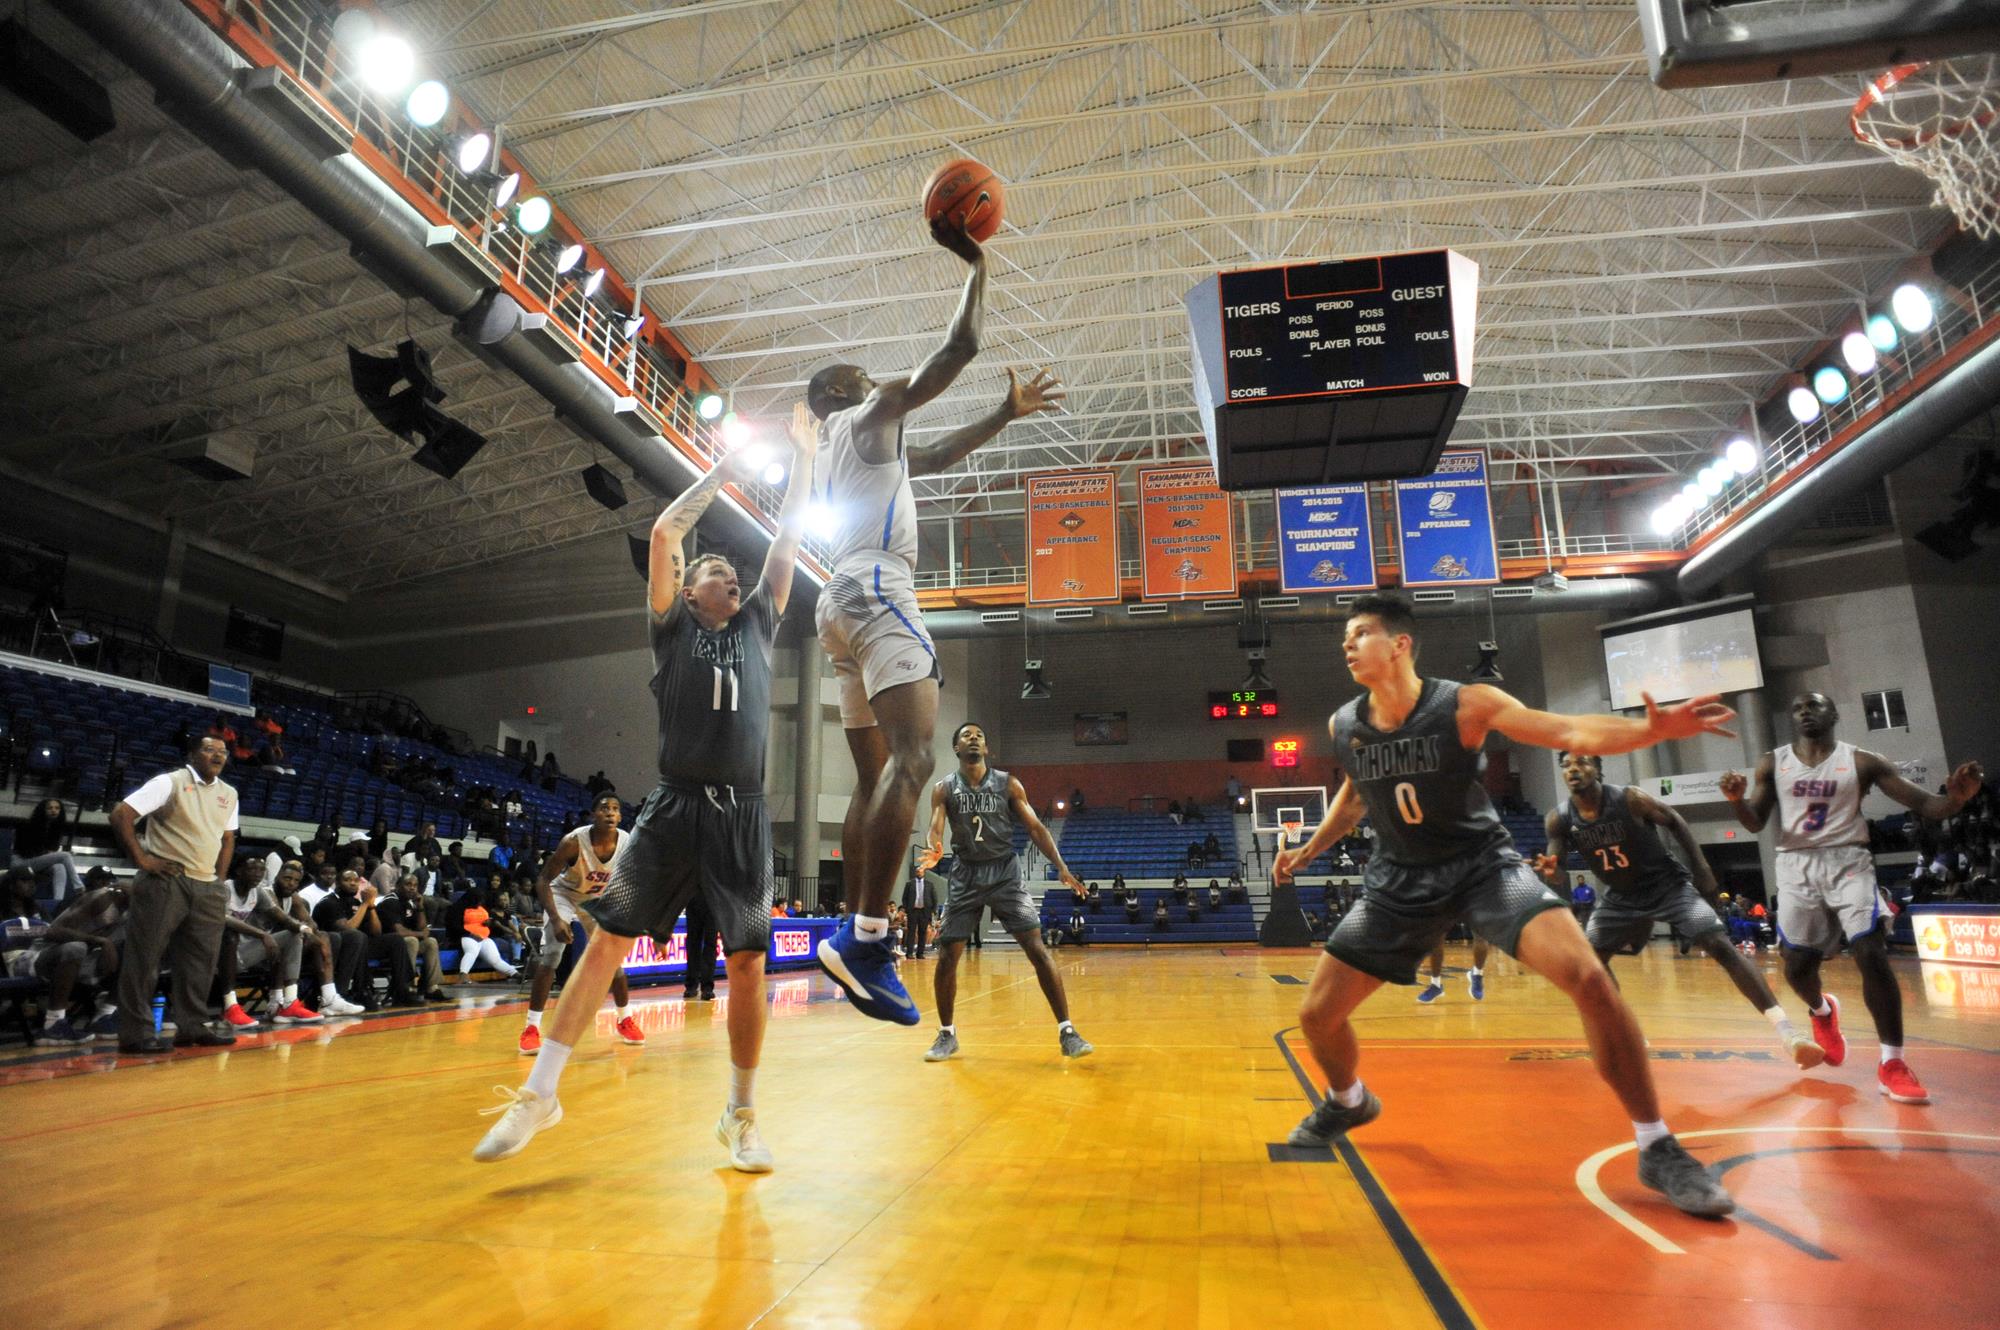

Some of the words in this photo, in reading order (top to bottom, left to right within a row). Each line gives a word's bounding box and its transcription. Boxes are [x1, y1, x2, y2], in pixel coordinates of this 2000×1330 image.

[1391, 285, 1446, 302] GUEST
[1225, 301, 1281, 319] TIGERS
[1316, 300, 1354, 312] PERIOD
[1359, 308, 1384, 319] POSS
[1288, 315, 1313, 325] POSS
[1289, 329, 1319, 340] BONUS
[1355, 323, 1386, 334] BONUS
[1415, 330, 1450, 342] FOULS
[1310, 338, 1351, 351] PLAYER
[1356, 336, 1385, 347] FOUL
[1229, 347, 1263, 359] FOULS
[1423, 372, 1450, 382] WON
[1326, 379, 1365, 391] MATCH
[1231, 387, 1268, 398] SCORE
[1148, 472, 1193, 482] SAVANNAH
[1194, 471, 1217, 480] STAT
[1035, 480, 1080, 490] SAVANNAH
[1081, 478, 1108, 487] STATE
[1435, 479, 1485, 489] BASKETBALL
[1033, 487, 1106, 497] UNIVERSITY
[1316, 486, 1364, 495] BASKETBALL
[1172, 493, 1225, 502] BASKETBALL
[1059, 500, 1110, 509] BASKETBALL
[1419, 519, 1471, 529] APPEARANCE
[1151, 536, 1189, 545] REGULAR
[1190, 534, 1222, 543] SEASON
[1287, 527, 1359, 540] TOURNAMENT
[1046, 535, 1098, 545] APPEARANCE
[1164, 545, 1212, 555] CHAMPIONS
[1295, 541, 1356, 552] CHAMPIONS
[712, 665, 739, 712] 11
[1240, 705, 1247, 716] 2
[1274, 751, 1297, 767] 25
[1353, 734, 1440, 782] THOMAS
[1792, 780, 1837, 798] SSU
[957, 792, 998, 814] THOMAS
[1395, 782, 1424, 825] 0
[1802, 802, 1829, 832] 3
[972, 815, 985, 842] 2
[1594, 844, 1630, 871] 23
[1947, 919, 1985, 941] Today
[775, 932, 809, 954] TIGERS
[1955, 940, 1973, 956] be
[1973, 940, 1997, 957] the
